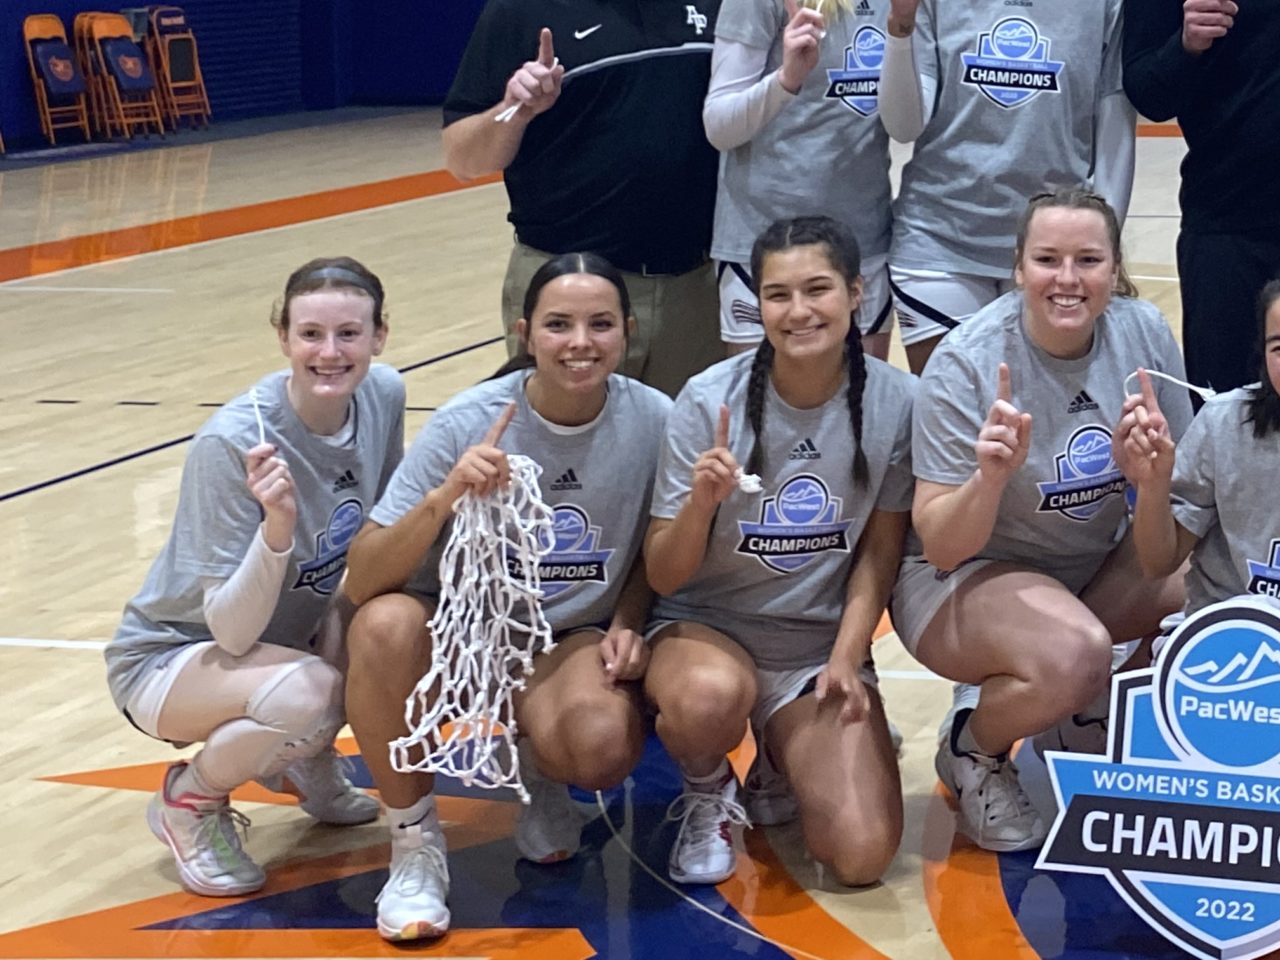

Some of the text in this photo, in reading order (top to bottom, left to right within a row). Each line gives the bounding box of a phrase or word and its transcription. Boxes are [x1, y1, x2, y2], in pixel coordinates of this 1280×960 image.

[835, 81, 880, 95] CHAMP
[970, 68, 1051, 87] CHAMPIONS
[1049, 481, 1127, 508] CHAMPION
[748, 534, 840, 552] CHAMPIONS
[1092, 770, 1209, 798] WOMEN'S
[1195, 897, 1256, 922] 2022
